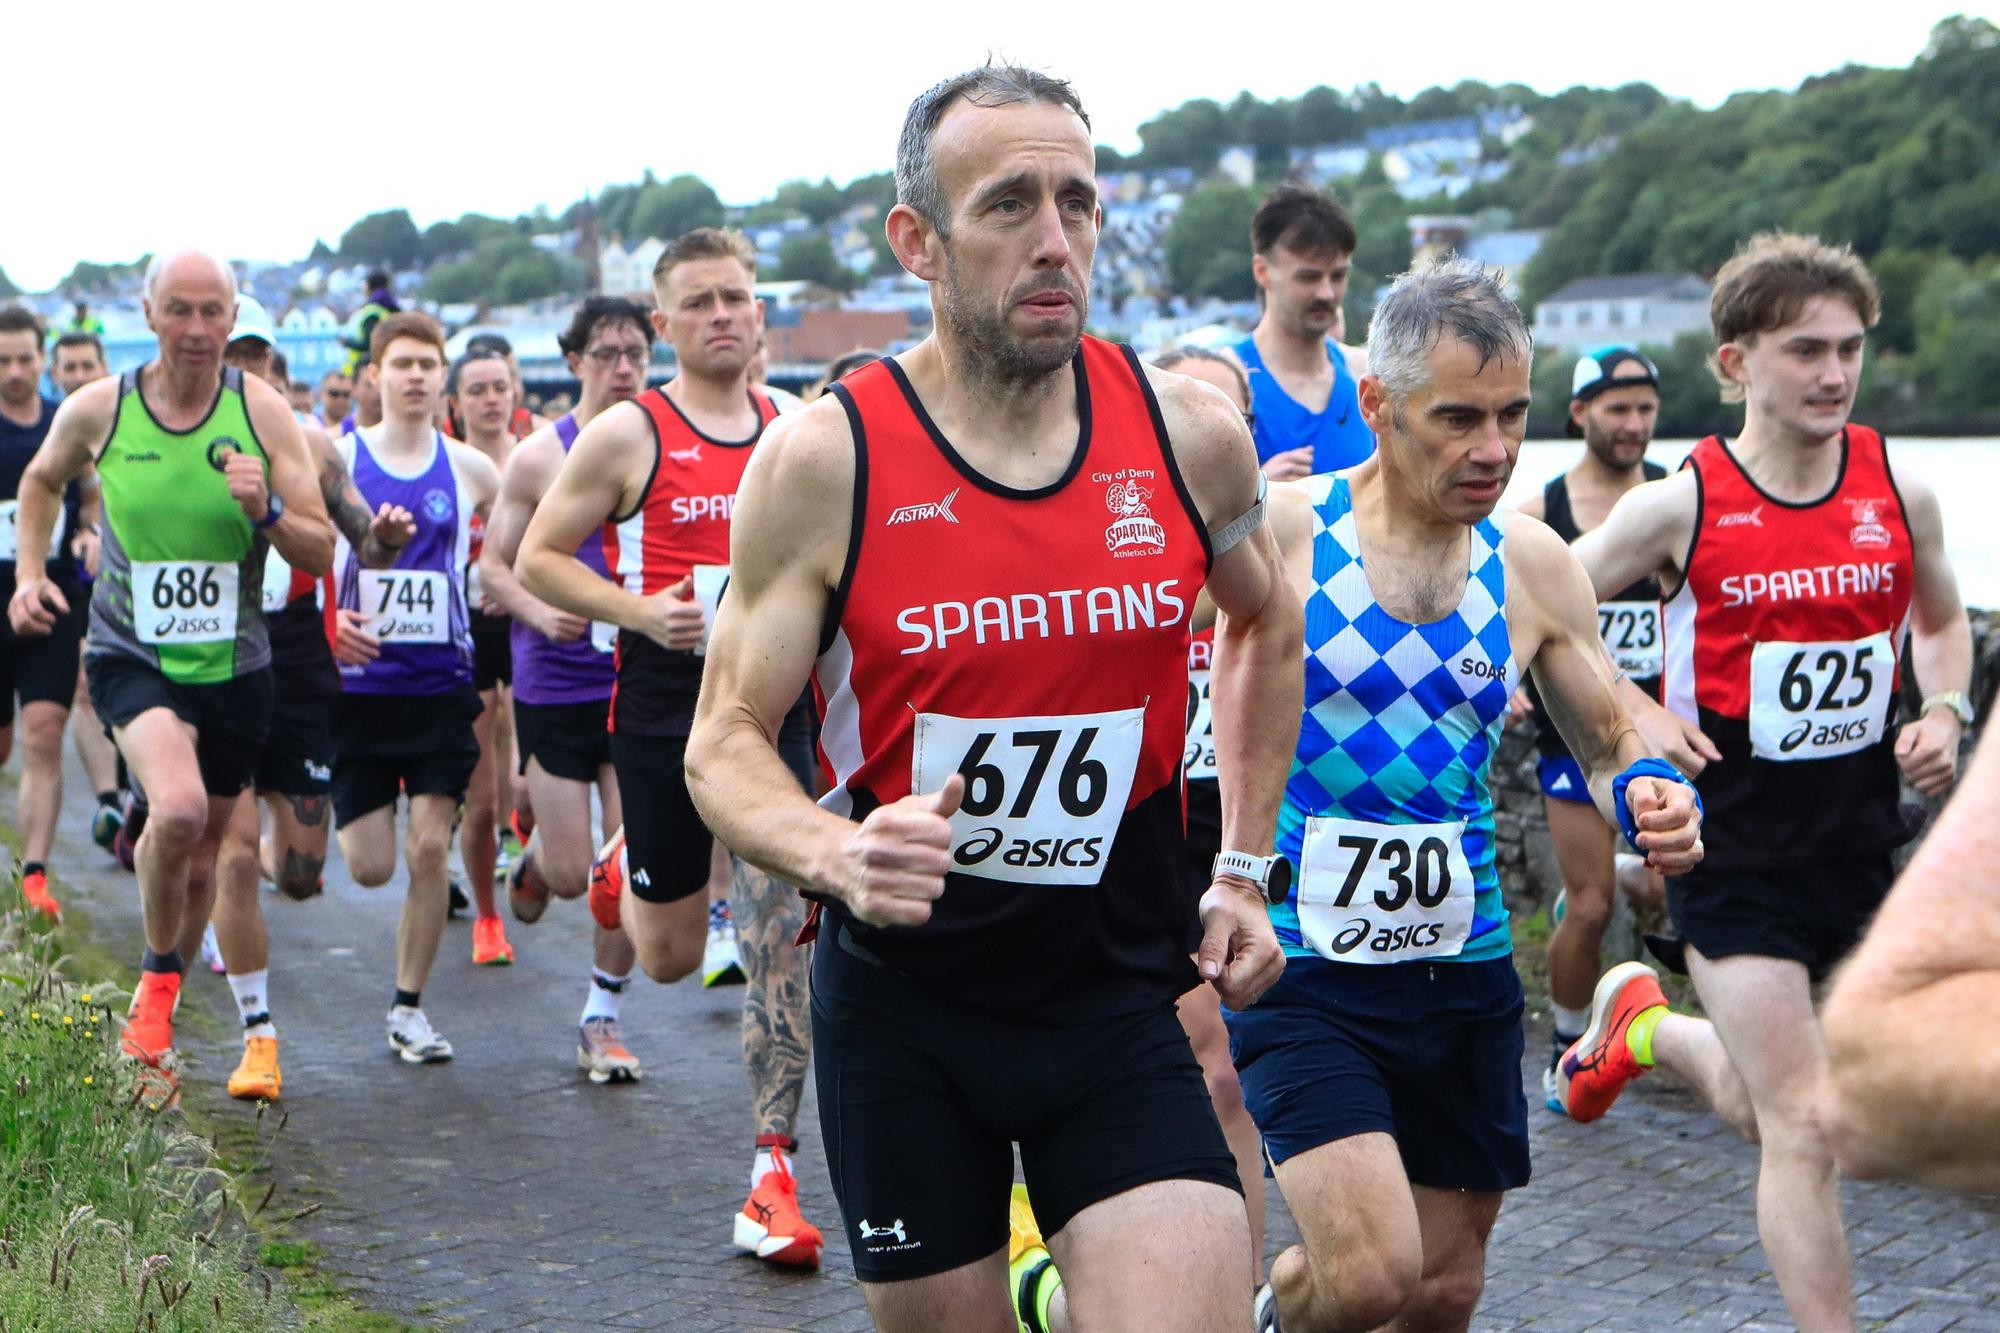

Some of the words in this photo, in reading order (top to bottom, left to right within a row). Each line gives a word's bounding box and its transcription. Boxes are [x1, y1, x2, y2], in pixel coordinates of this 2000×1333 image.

[1092, 471, 1112, 483] City
[1115, 469, 1127, 479] of
[1128, 469, 1155, 480] Derry
[1107, 523, 1164, 549] SPARTANS
[1113, 549, 1147, 560] Athletics
[1148, 546, 1164, 556] Club
[152, 566, 220, 609] 686
[377, 578, 434, 614] 744
[1720, 562, 1896, 608] SPARTANS
[177, 617, 220, 633] asics
[396, 620, 434, 635] asics
[896, 579, 1184, 655] SPARTANS
[1598, 610, 1656, 649] 723
[1460, 658, 1507, 682] SOAR
[1779, 646, 1873, 712] 625
[1812, 718, 1869, 746] asics
[957, 727, 1108, 818] 676
[1002, 837, 1103, 867] asics
[1333, 835, 1451, 911] 730
[1370, 922, 1444, 951] asics
